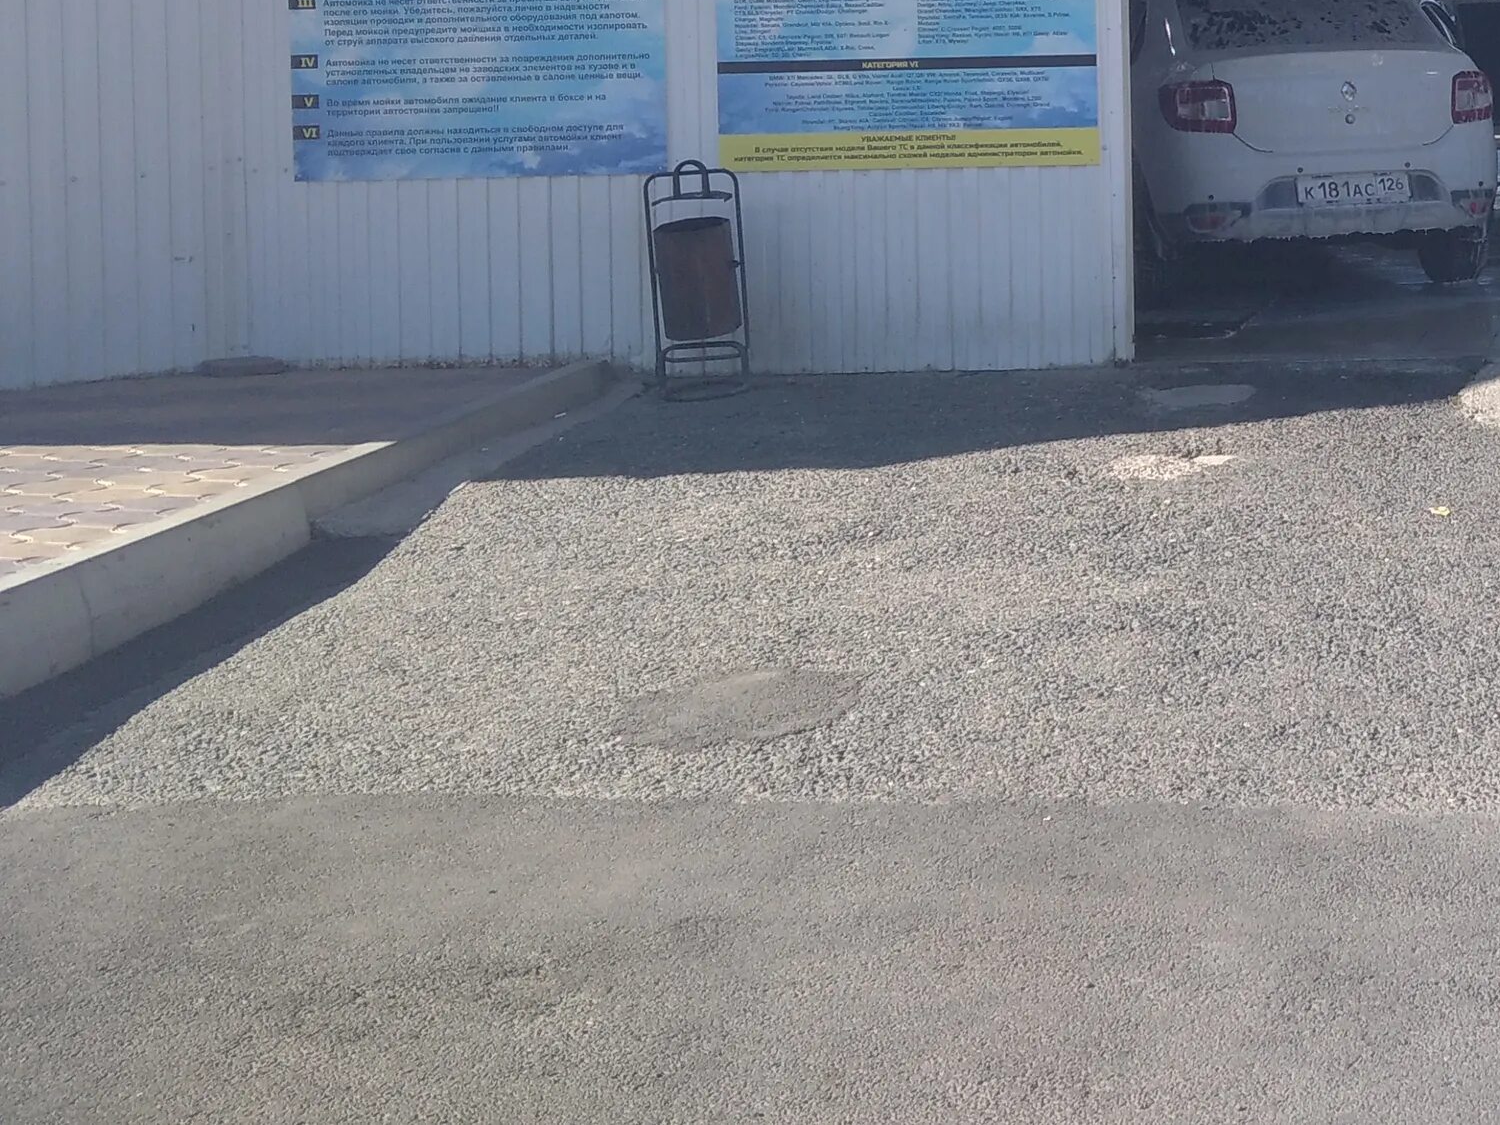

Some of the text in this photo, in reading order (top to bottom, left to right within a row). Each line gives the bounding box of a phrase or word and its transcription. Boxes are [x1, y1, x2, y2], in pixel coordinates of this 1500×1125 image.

[861, 60, 918, 69] КАТЕГОРИЯ VI
[1304, 178, 1403, 200] К181АС 126
